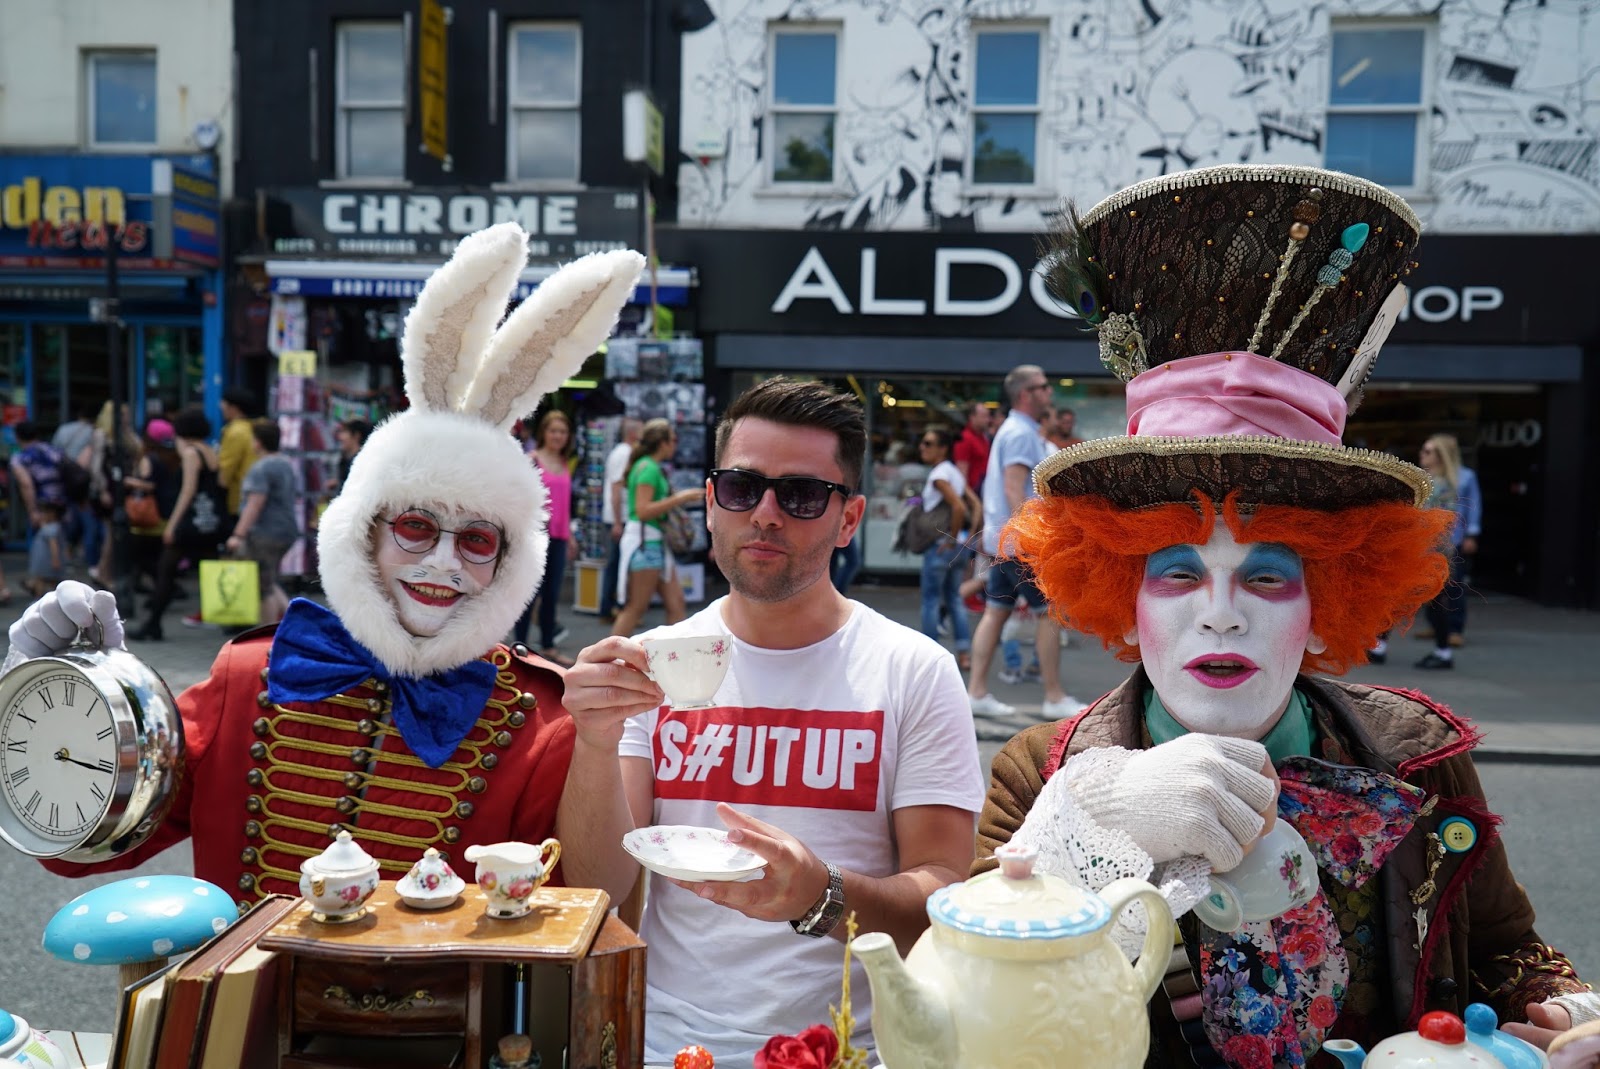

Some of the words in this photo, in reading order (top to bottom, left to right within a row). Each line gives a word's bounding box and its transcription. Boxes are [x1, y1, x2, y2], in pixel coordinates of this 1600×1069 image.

[0, 176, 126, 229] den
[323, 195, 578, 235] CHROME
[37, 686, 55, 713] XI
[62, 681, 76, 707] XII
[17, 707, 37, 730] X
[86, 697, 100, 717] I
[7, 738, 28, 754] IX
[96, 727, 113, 741] II
[10, 767, 30, 788] VIII
[25, 790, 42, 816] VII
[48, 802, 60, 829] VI
[76, 801, 87, 826] V
